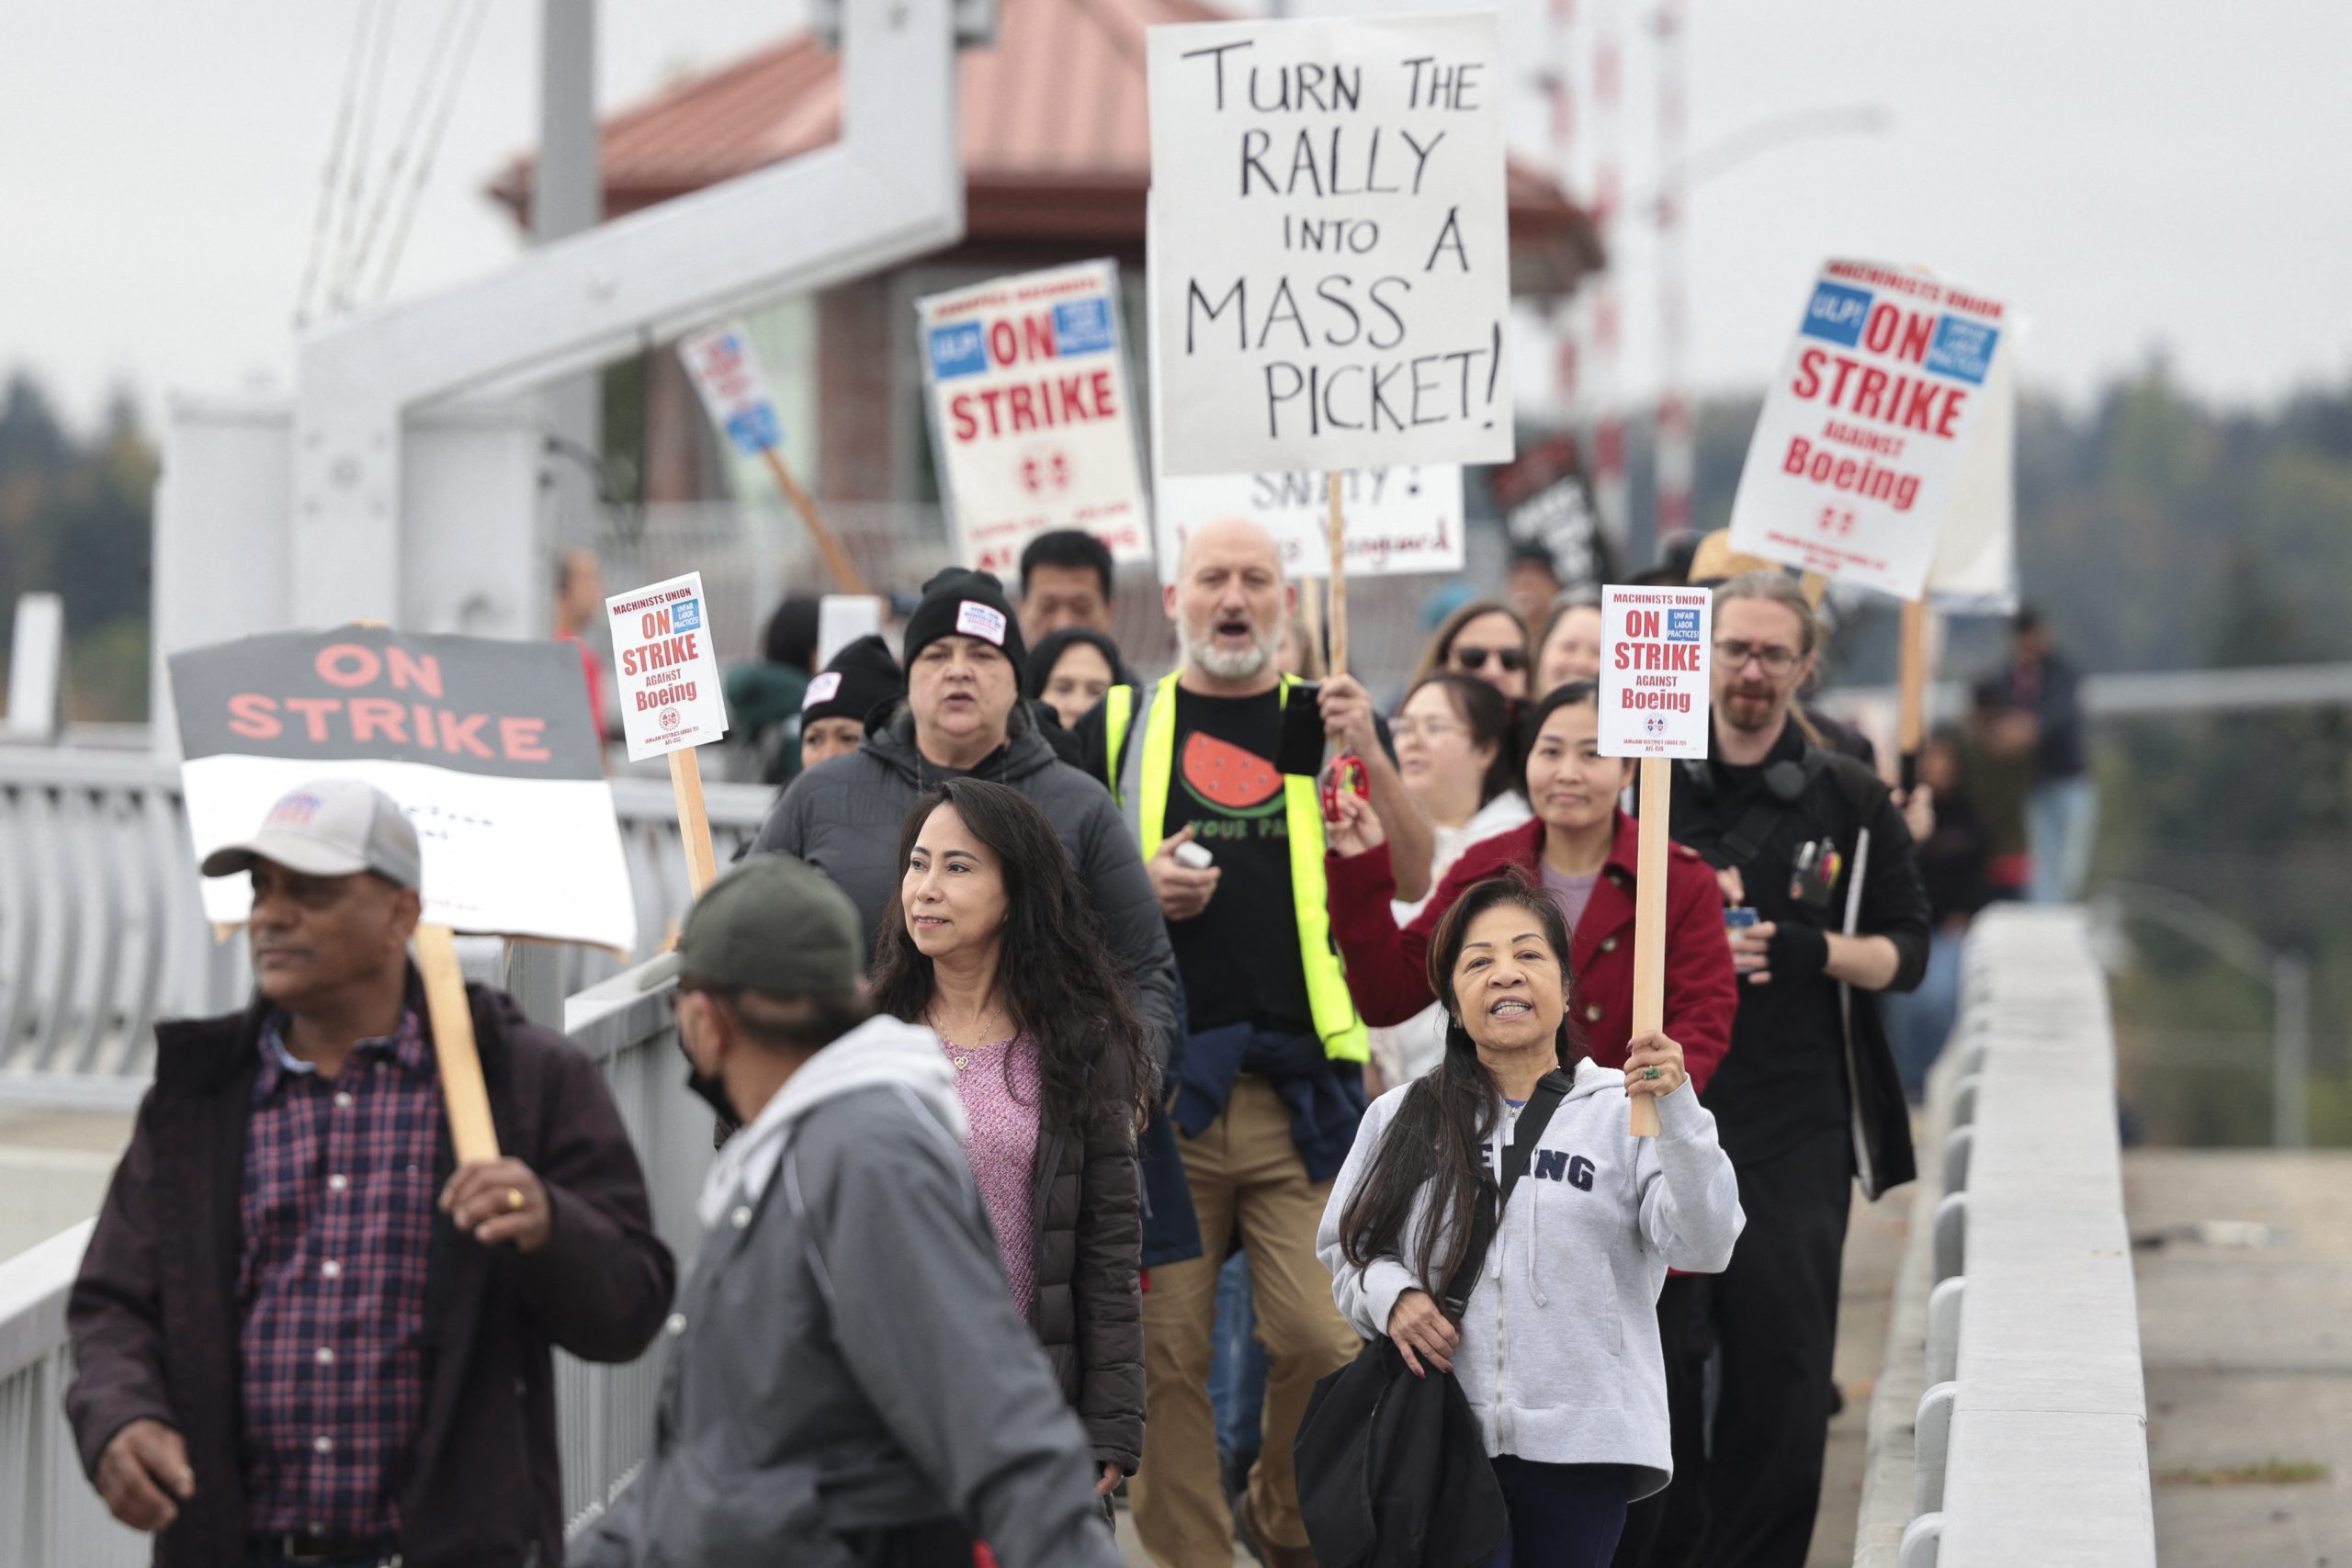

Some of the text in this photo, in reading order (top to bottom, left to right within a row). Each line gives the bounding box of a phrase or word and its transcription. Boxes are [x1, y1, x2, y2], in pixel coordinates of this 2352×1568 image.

[1182, 39, 1485, 112] TURN THE
[1240, 126, 1445, 197] RALLY
[1283, 206, 1469, 272] INTO A
[1186, 275, 1411, 355] MASS
[989, 312, 1056, 369] ON
[1864, 303, 1936, 365] ON
[1265, 321, 1501, 438] PICKET!
[1793, 348, 1968, 440] STRIKE
[950, 369, 1117, 443] STRIKE
[1821, 420, 1906, 457] AGAINST
[1782, 436, 1922, 511] Boeing
[613, 587, 692, 615] MACHINISTS UNION
[678, 610, 694, 620] LABOR
[1613, 593, 1705, 605] MACHINISTS UNION
[1673, 611, 1694, 620] UNFAIR
[642, 608, 671, 639] ON
[1625, 610, 1659, 638] ON
[1674, 620, 1693, 629] LABOR
[315, 645, 444, 699] ON
[622, 633, 699, 676] STRIKE
[1614, 642, 1701, 671] STRIKE
[635, 681, 697, 712] Boeing
[646, 669, 682, 688] AGAINST
[1635, 675, 1678, 687] AGAINST
[1622, 688, 1690, 713] Boeing
[228, 694, 551, 761] STRIKE
[1191, 819, 1248, 840] YOUR
